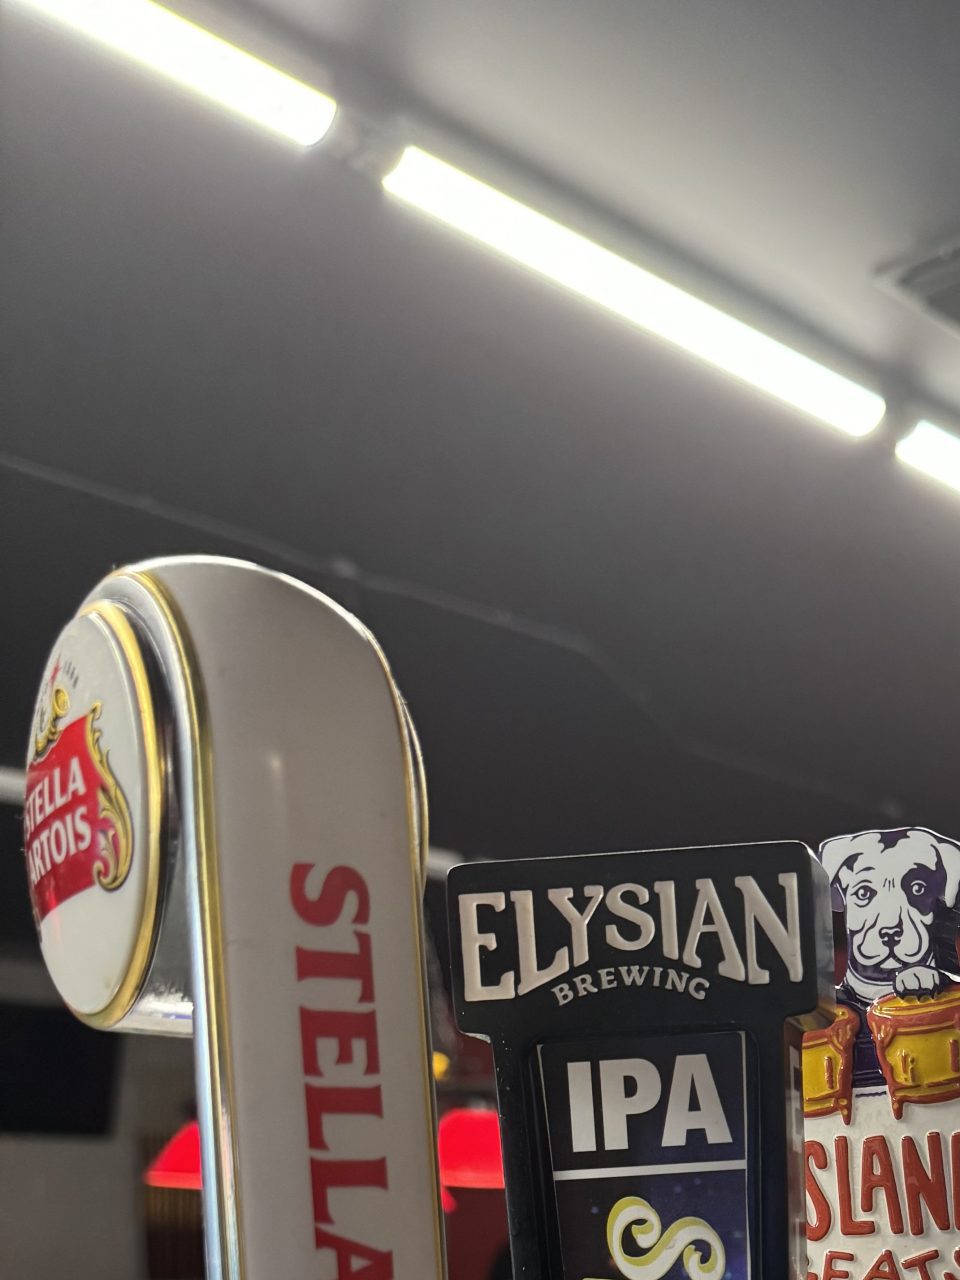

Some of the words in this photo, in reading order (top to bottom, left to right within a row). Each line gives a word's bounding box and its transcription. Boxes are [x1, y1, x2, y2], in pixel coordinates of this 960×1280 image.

[458, 872, 803, 1001] ELYSIAN
[552, 965, 710, 1006] BREWING
[567, 1053, 733, 1152] IPA
